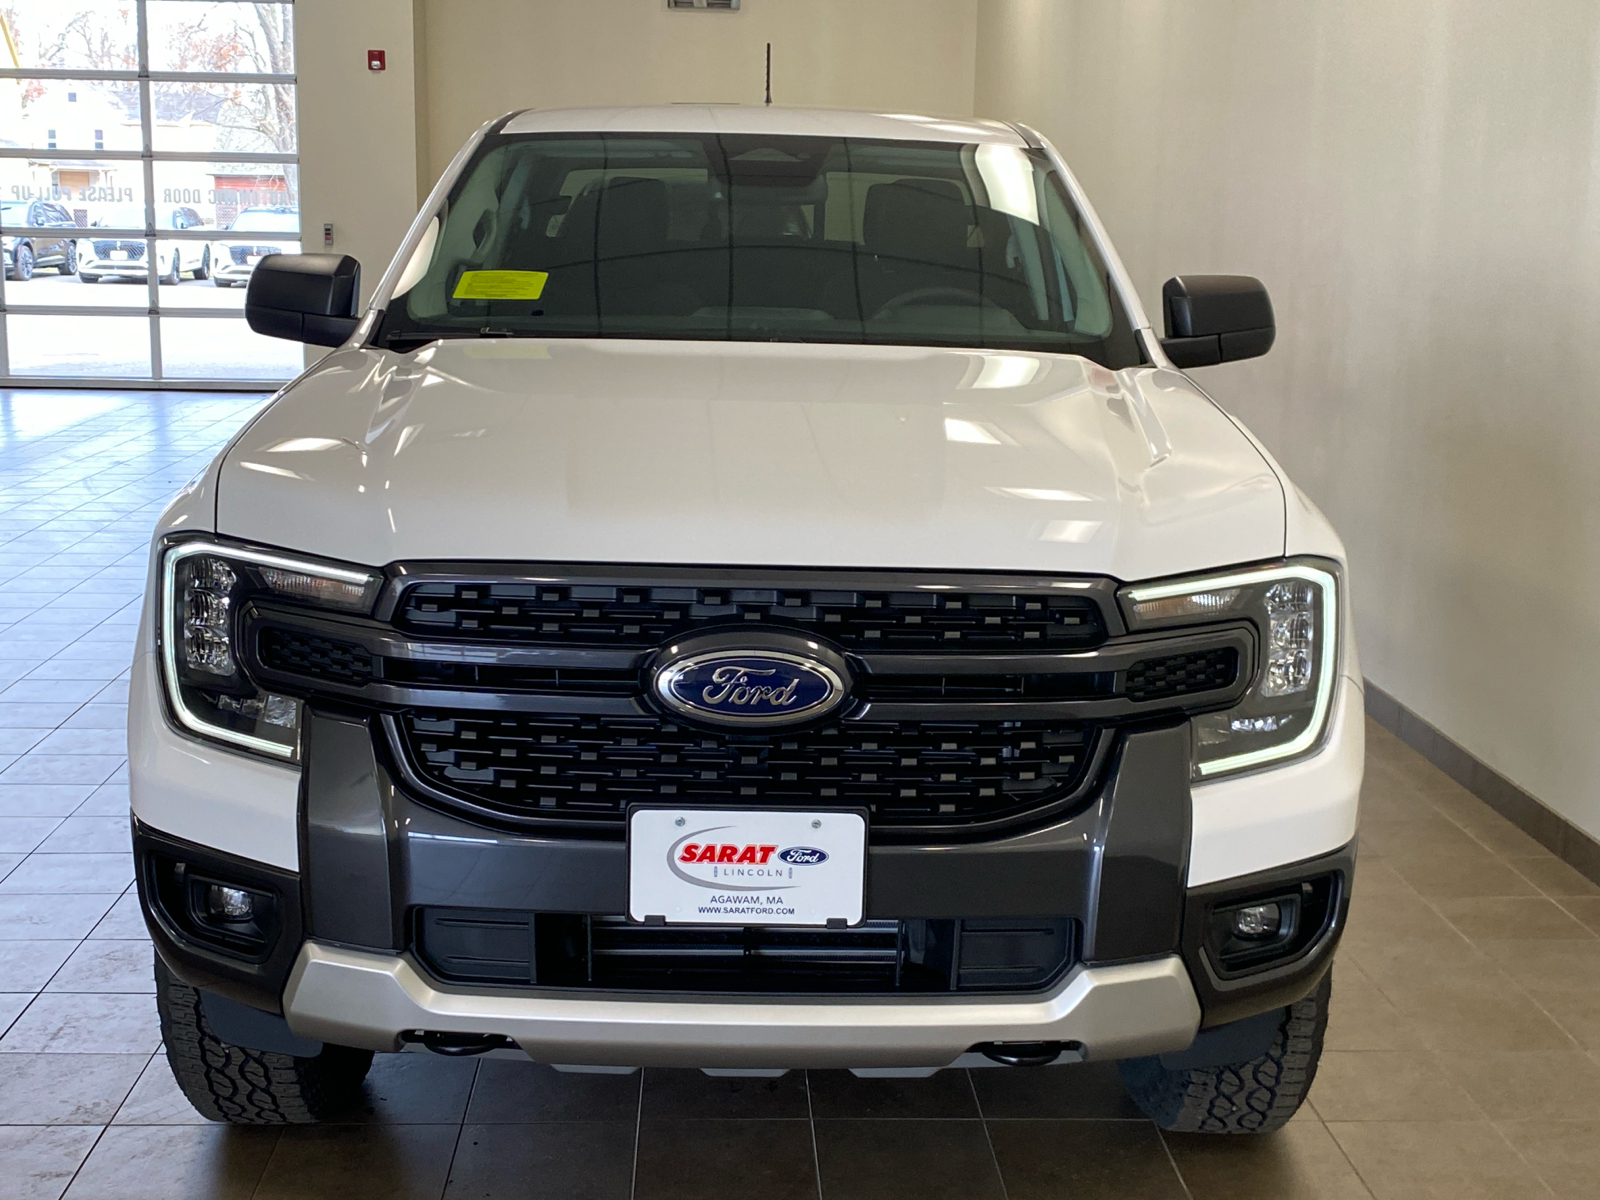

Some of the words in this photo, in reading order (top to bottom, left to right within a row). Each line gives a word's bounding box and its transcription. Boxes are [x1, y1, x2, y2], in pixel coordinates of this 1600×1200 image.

[702, 666, 799, 706] Ford
[678, 843, 778, 865] SARAT
[786, 848, 819, 863] Ford
[723, 868, 783, 877] LINCOLN
[710, 895, 763, 905] AGAWAM,
[766, 896, 784, 905] MA
[698, 906, 795, 915] WWW.SARATFORD.COM
